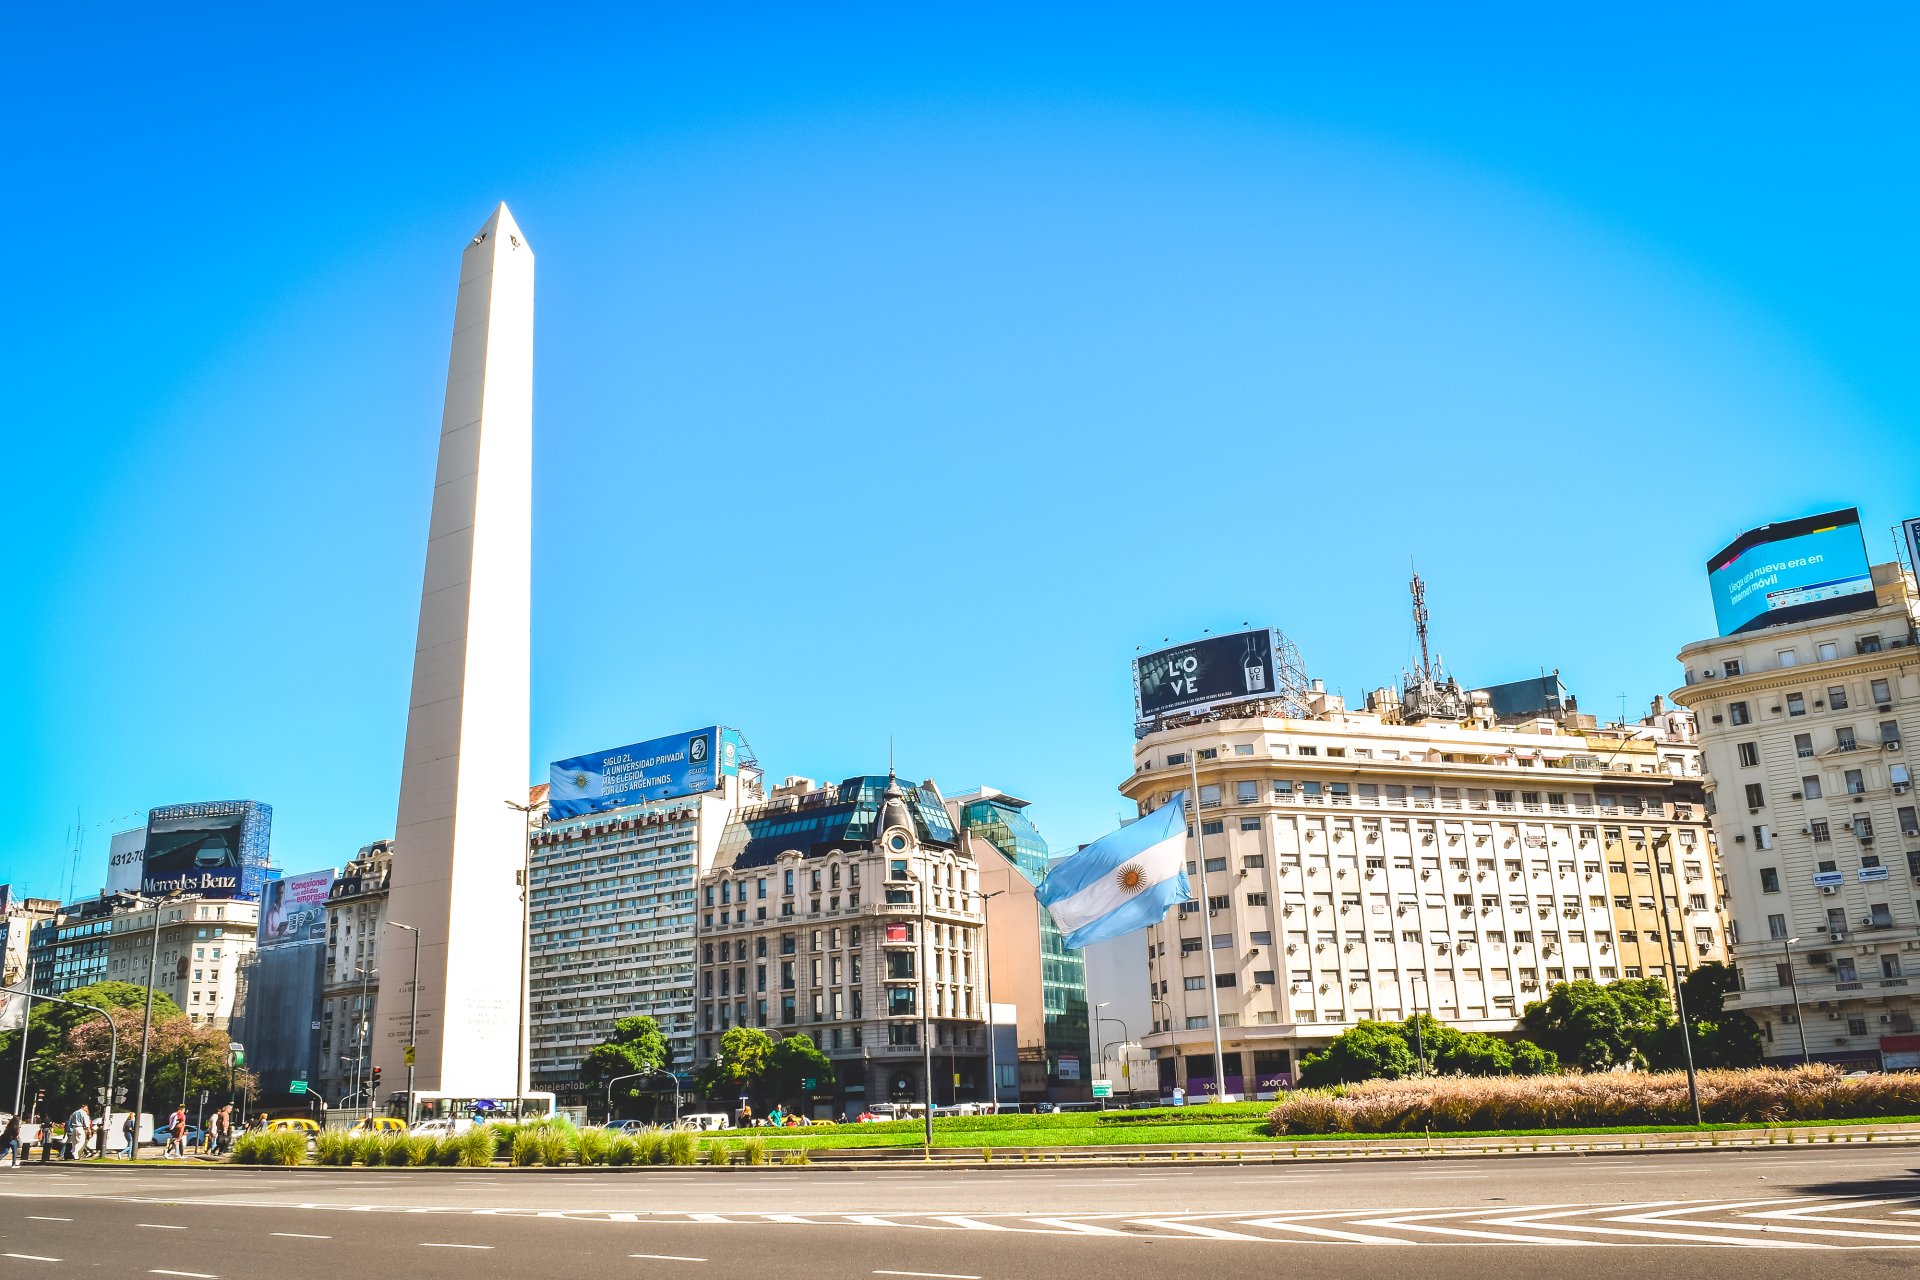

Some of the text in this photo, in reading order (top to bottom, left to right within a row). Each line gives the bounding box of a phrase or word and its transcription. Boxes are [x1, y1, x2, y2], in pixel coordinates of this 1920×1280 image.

[1754, 561, 1786, 577] nueva
[1788, 557, 1807, 568] era
[1809, 554, 1824, 564] en
[1752, 574, 1778, 592] móvil
[602, 767, 611, 778] LA
[612, 759, 655, 774] UNIVERSIDAD
[656, 753, 684, 766] PRIVADA
[603, 754, 633, 767] SIGLO 21,
[616, 770, 644, 785] ELEGIDA
[629, 775, 673, 790] ARGENTINOS.
[143, 873, 236, 893] Mercedes-Benz
[291, 878, 327, 890] Conexiones
[297, 892, 328, 902] empresas
